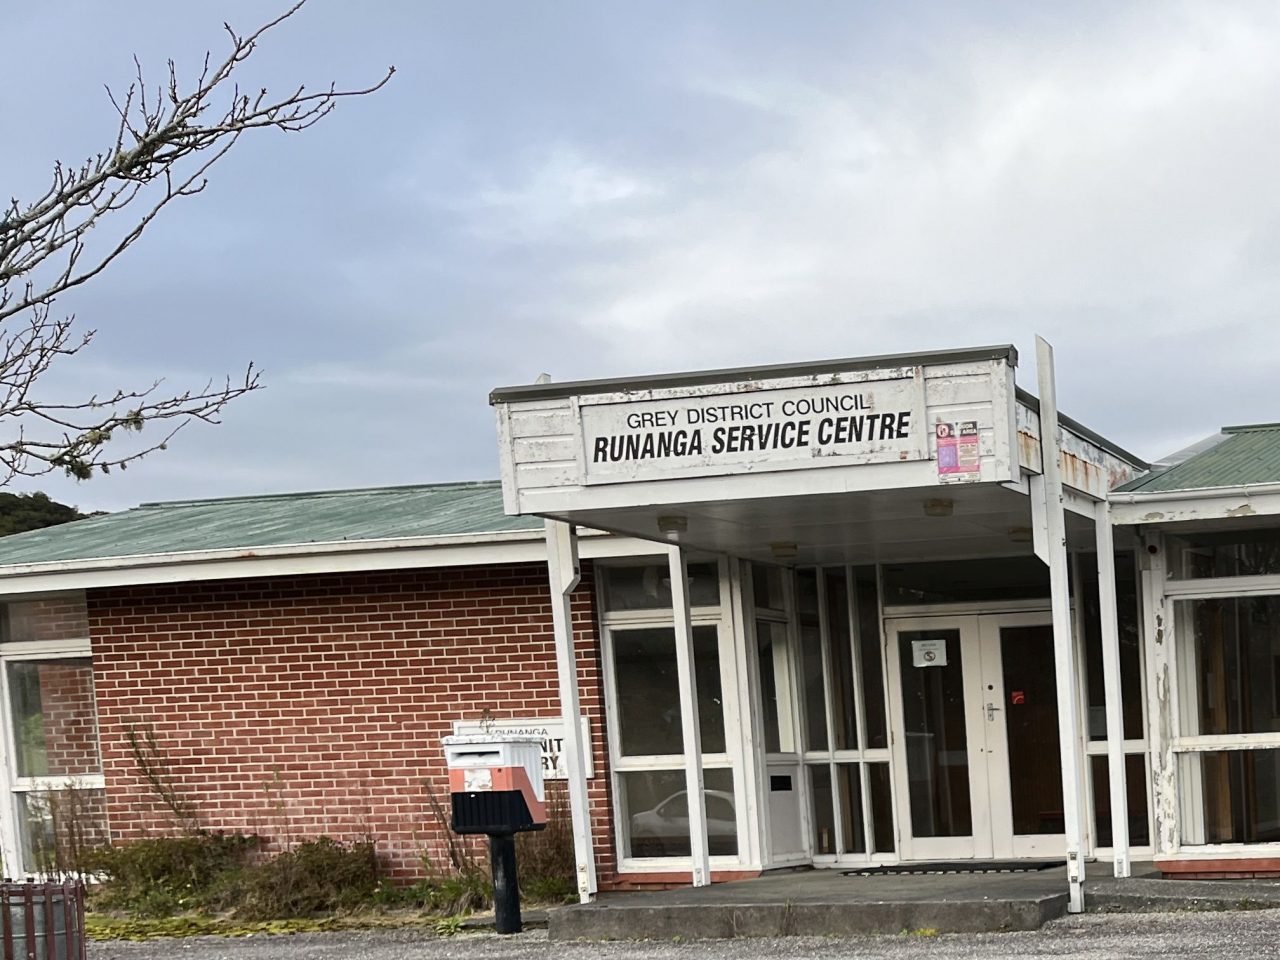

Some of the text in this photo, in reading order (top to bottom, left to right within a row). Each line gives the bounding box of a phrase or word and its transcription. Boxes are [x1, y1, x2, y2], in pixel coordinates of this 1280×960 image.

[626, 393, 871, 429] GREY DISTRICT COUNCIL
[593, 411, 911, 463] RUNANGA SERVICE CENTRE
